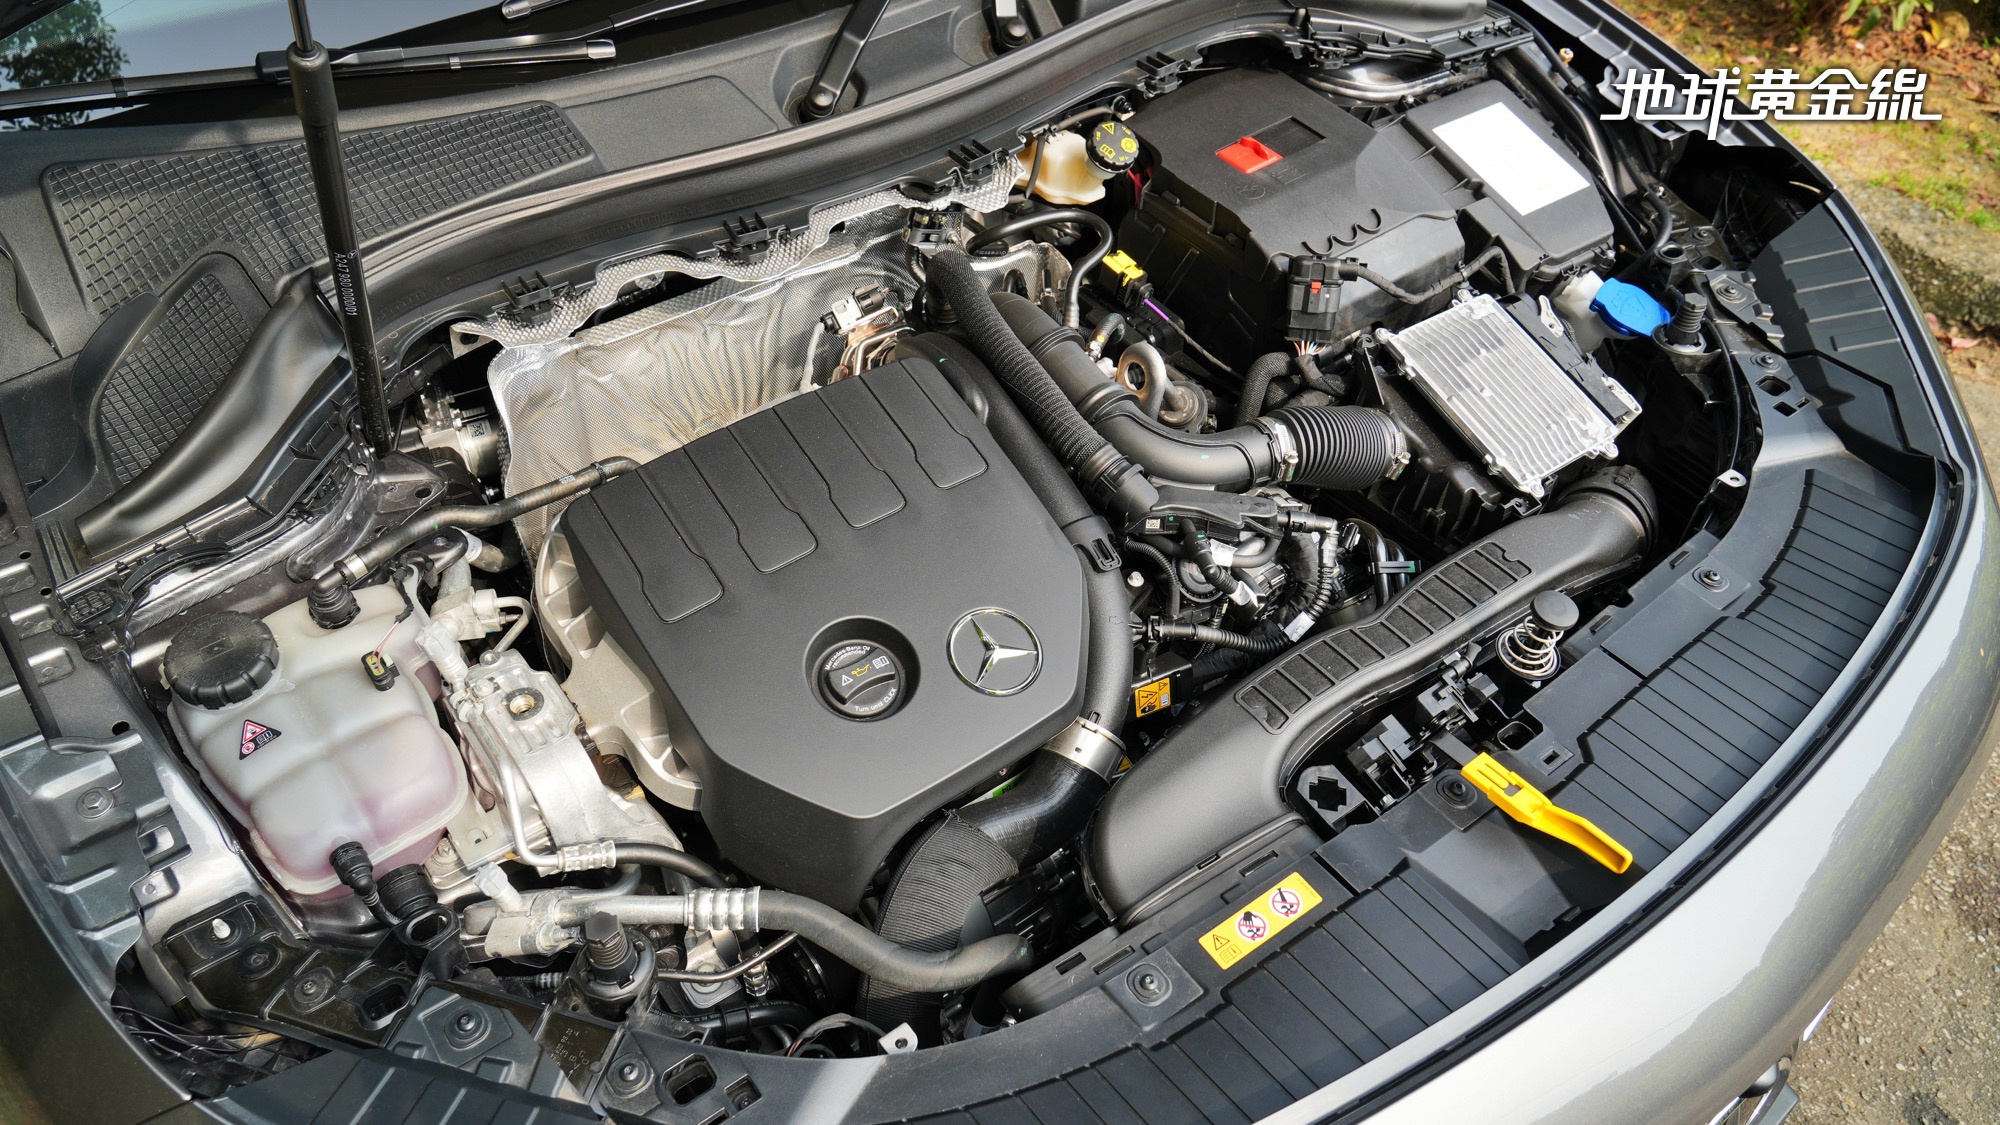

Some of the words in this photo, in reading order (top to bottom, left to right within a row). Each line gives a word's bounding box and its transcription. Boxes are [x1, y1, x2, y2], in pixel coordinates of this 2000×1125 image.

[333, 252, 349, 273] A247
[338, 273, 352, 287] 980
[824, 645, 861, 671] Mercedes-Benz
[832, 649, 866, 668] recommended
[870, 701, 883, 711] until
[883, 687, 897, 703] CLICK
